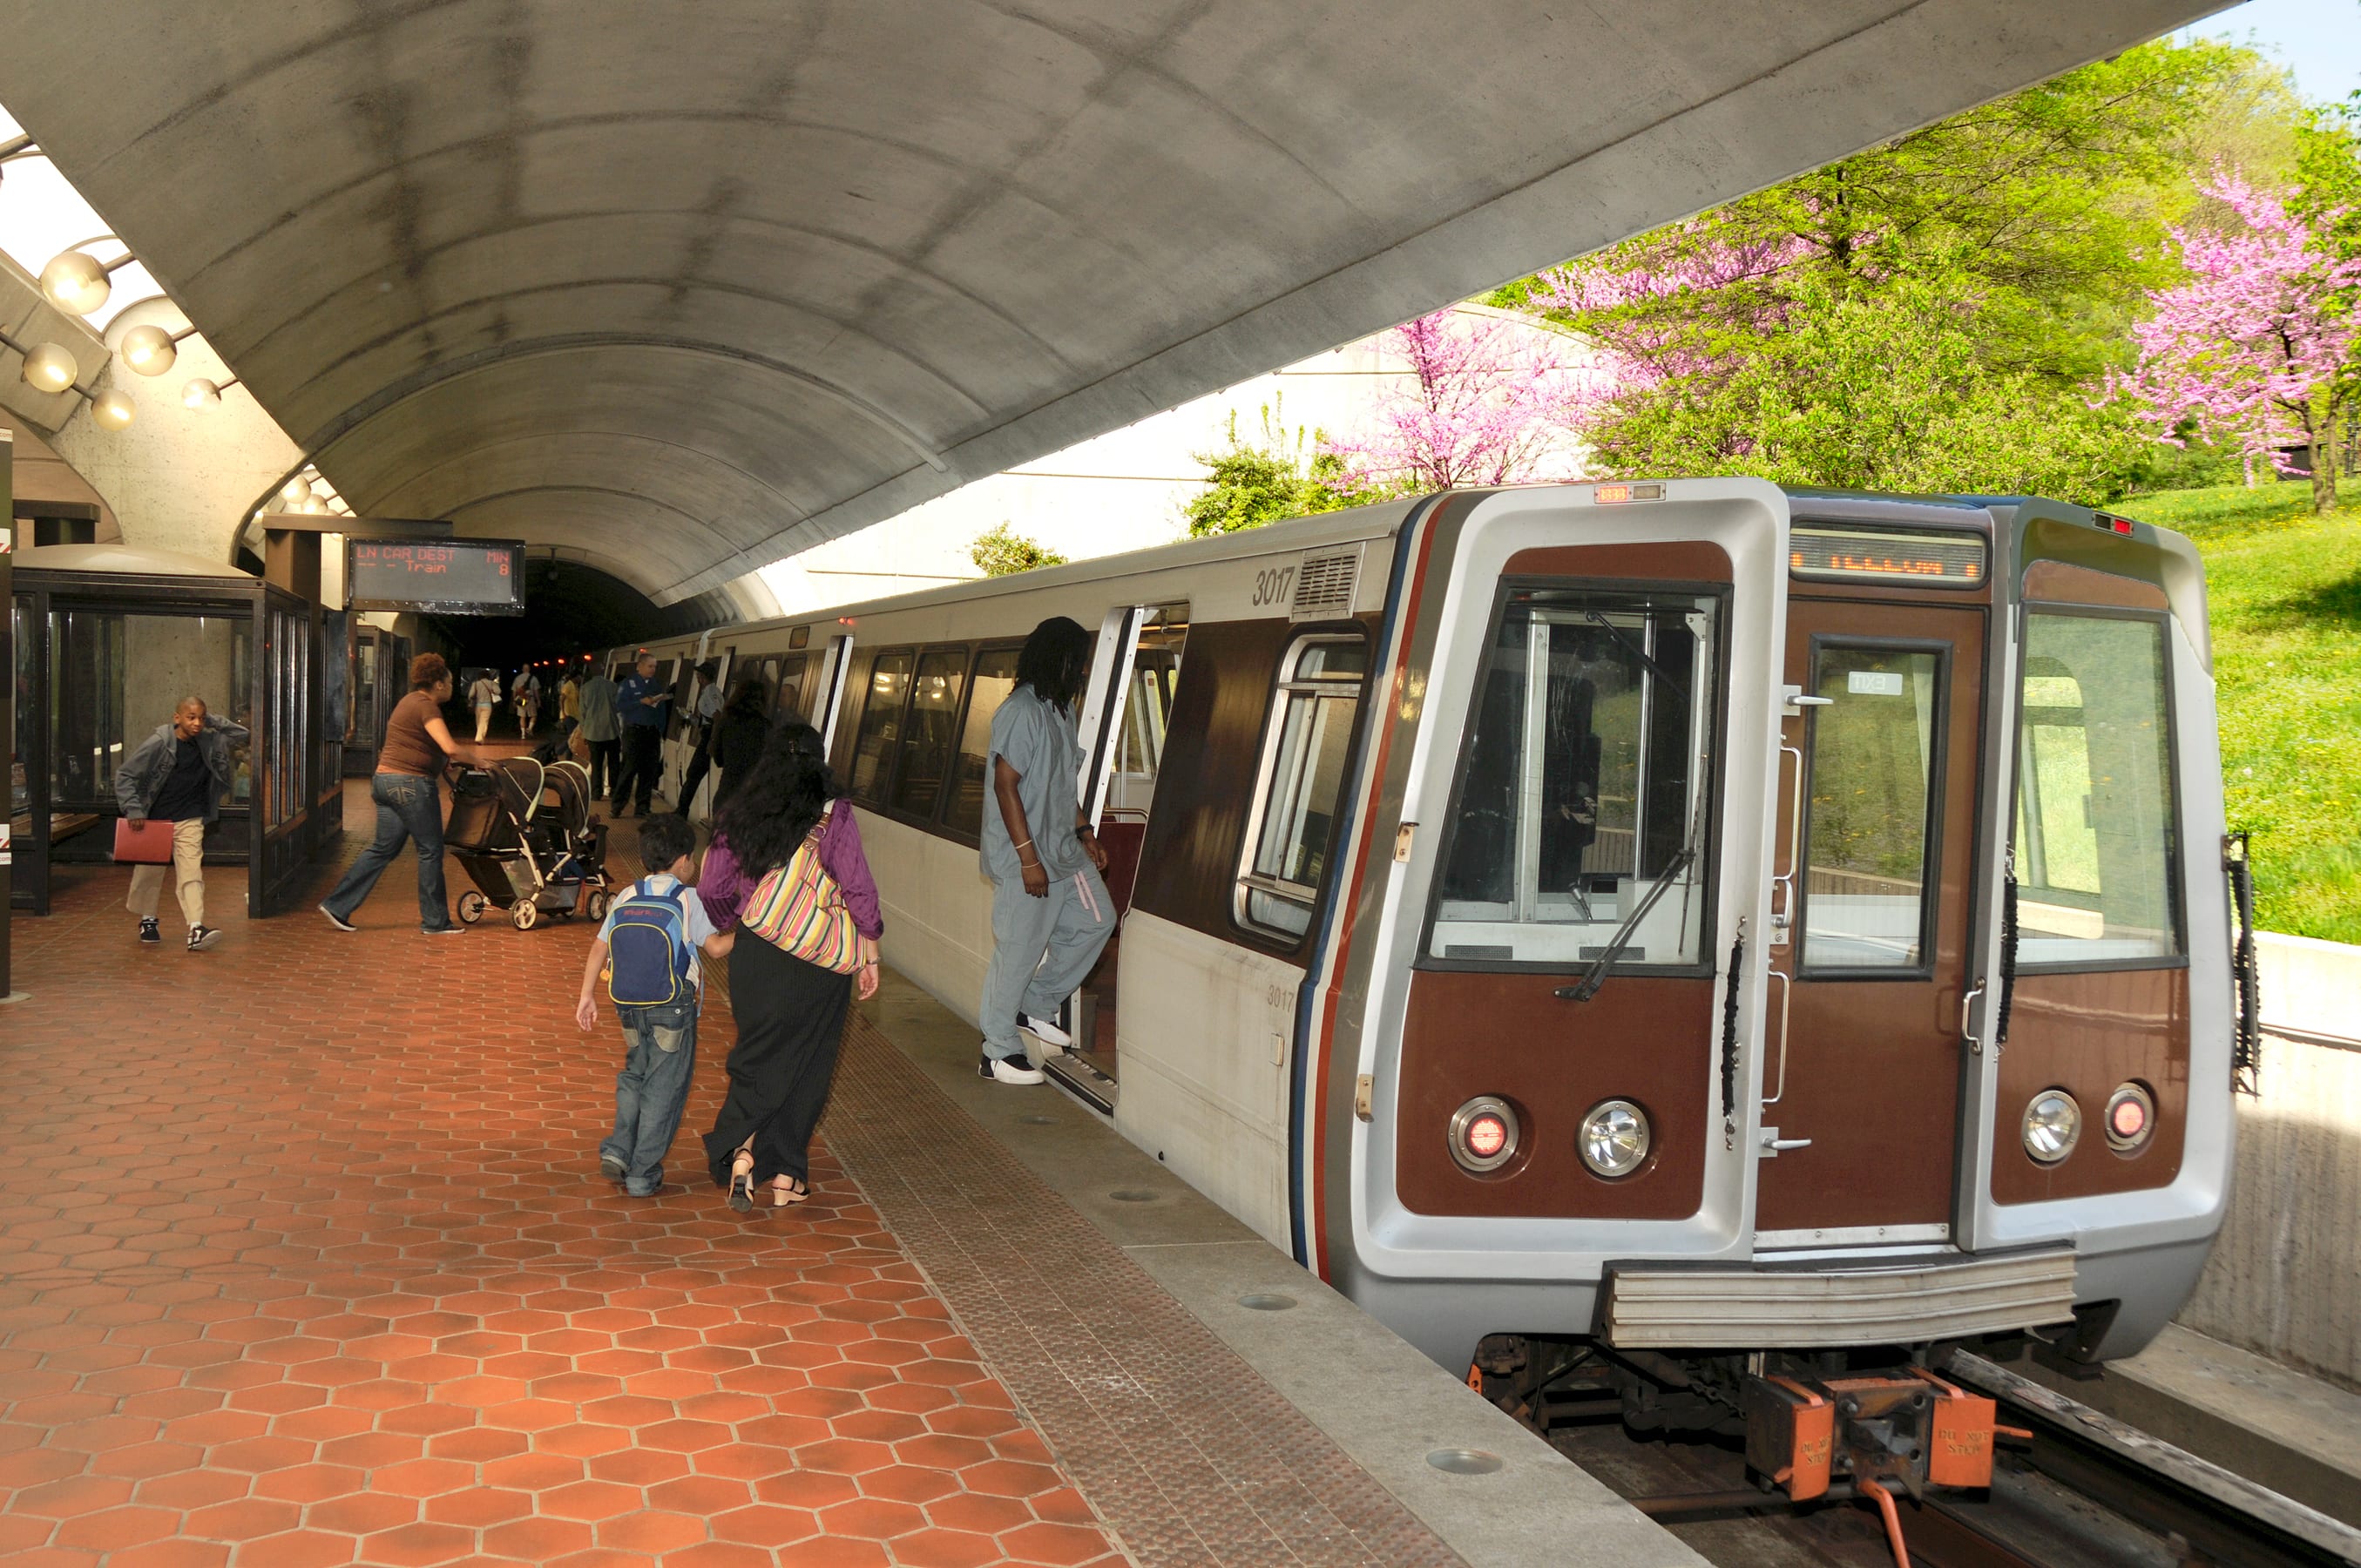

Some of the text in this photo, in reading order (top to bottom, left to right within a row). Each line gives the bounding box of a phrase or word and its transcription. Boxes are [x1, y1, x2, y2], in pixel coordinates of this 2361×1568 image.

[357, 547, 510, 564] LN CAR DEST MIN
[405, 560, 446, 573] Train
[498, 564, 510, 576] 8
[1253, 566, 1295, 606] 3017
[1268, 984, 1294, 1012] 3017
